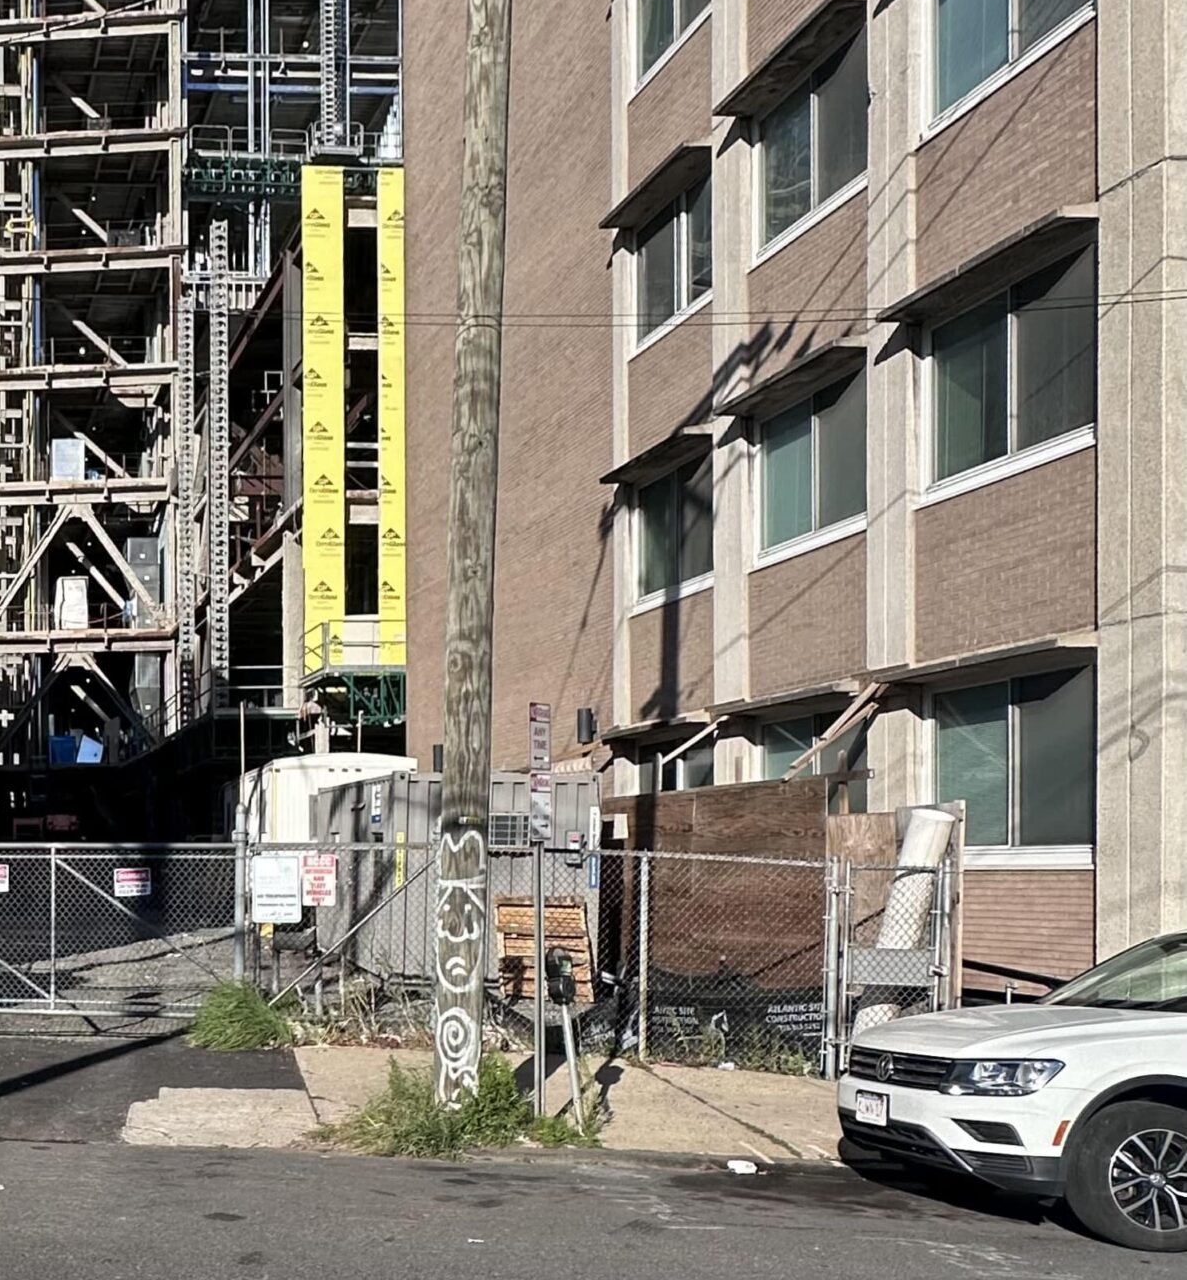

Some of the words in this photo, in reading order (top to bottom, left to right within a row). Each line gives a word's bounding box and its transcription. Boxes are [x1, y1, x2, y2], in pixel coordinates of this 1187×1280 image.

[534, 727, 546, 736] ANY
[533, 740, 547, 750] TIME
[767, 1004, 808, 1013] ATLANTIC
[765, 1013, 823, 1023] CONSTRUCTIO
